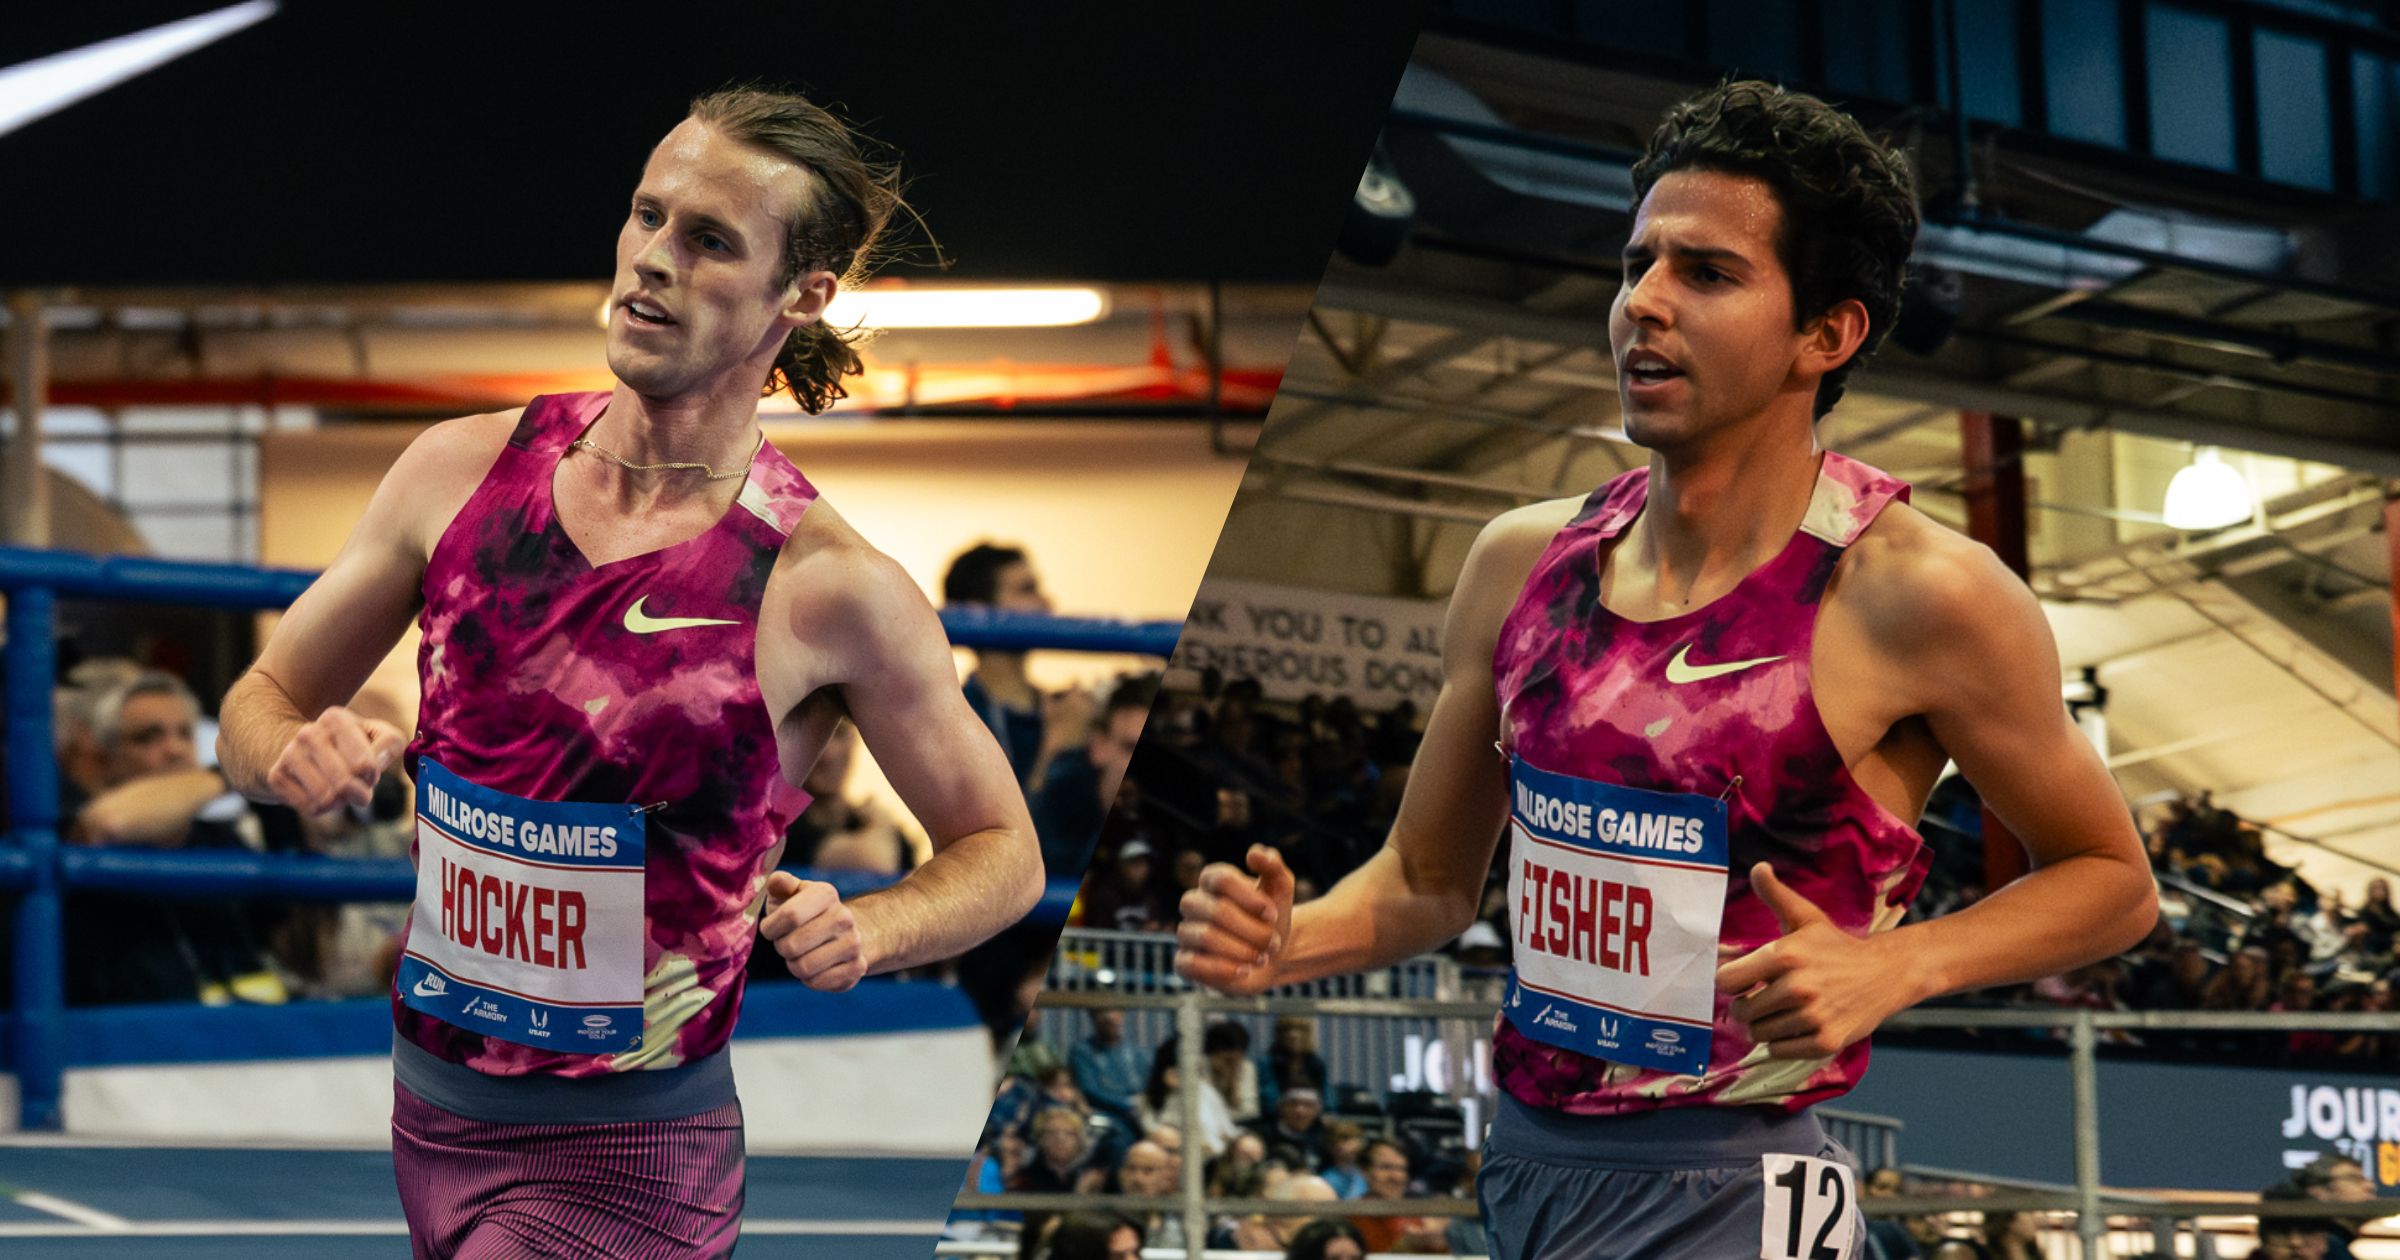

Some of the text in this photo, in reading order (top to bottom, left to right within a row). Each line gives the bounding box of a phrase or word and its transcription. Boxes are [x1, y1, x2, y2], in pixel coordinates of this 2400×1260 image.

[1246, 602, 1323, 643] YOU
[1339, 615, 1387, 651] TO
[1169, 638, 1347, 687] ENEROUS
[428, 783, 618, 858] MILLROSE GAMES
[1597, 808, 1704, 854] GAMES
[441, 856, 587, 969] HOCKER
[1519, 859, 1653, 976] FISHER
[424, 972, 446, 993] RUN
[483, 1001, 498, 1012] THE
[473, 1008, 508, 1023] ARMORY
[1775, 1160, 1845, 1260] 12
